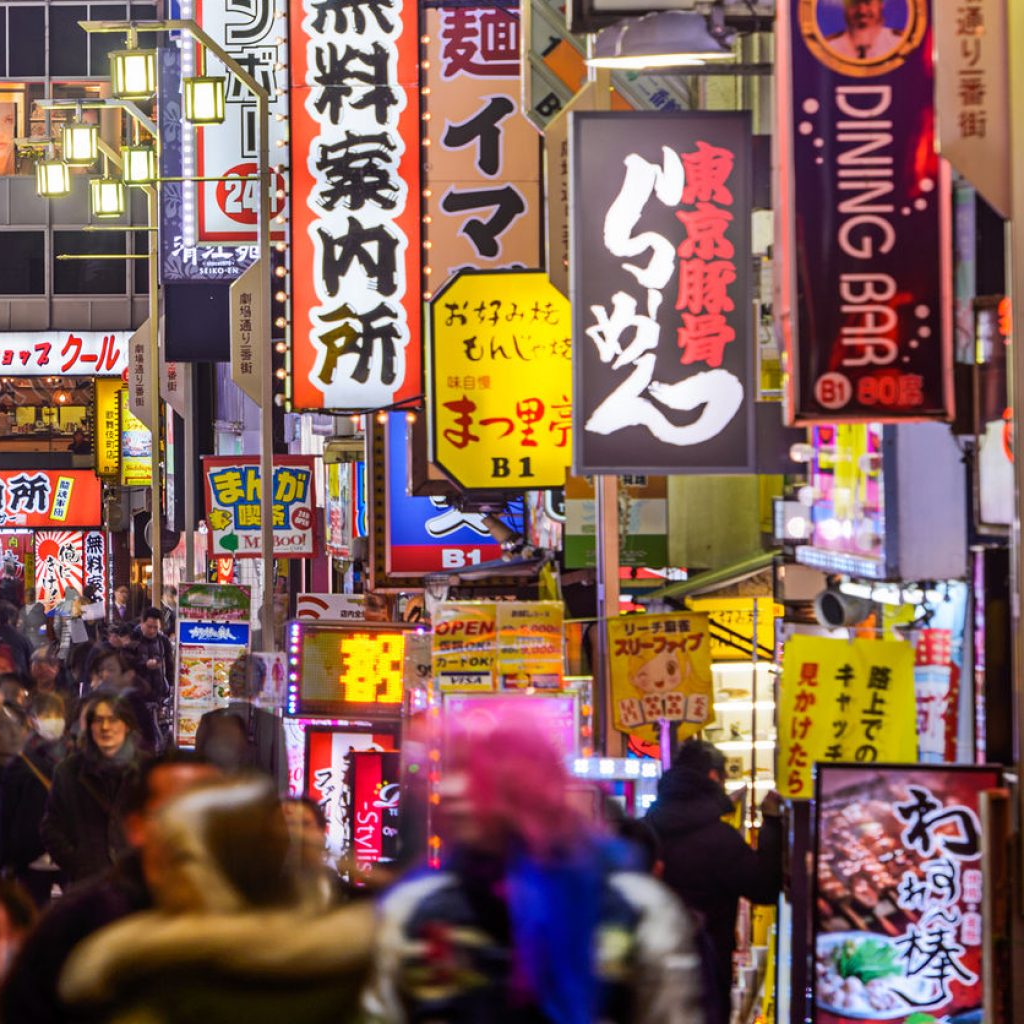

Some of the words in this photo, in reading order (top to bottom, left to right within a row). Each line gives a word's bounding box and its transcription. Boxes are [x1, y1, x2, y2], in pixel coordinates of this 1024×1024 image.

[835, 85, 896, 260] DINING
[239, 292, 254, 375] 劇場通り一番街
[840, 273, 898, 367] BAR
[60, 333, 121, 373] クール
[820, 378, 846, 404] B1
[491, 457, 536, 478] B1
[442, 548, 482, 569] B1
[435, 620, 496, 637] OPEN
[614, 633, 704, 657] スリーファイブ
[787, 662, 821, 795] 見かけたら
